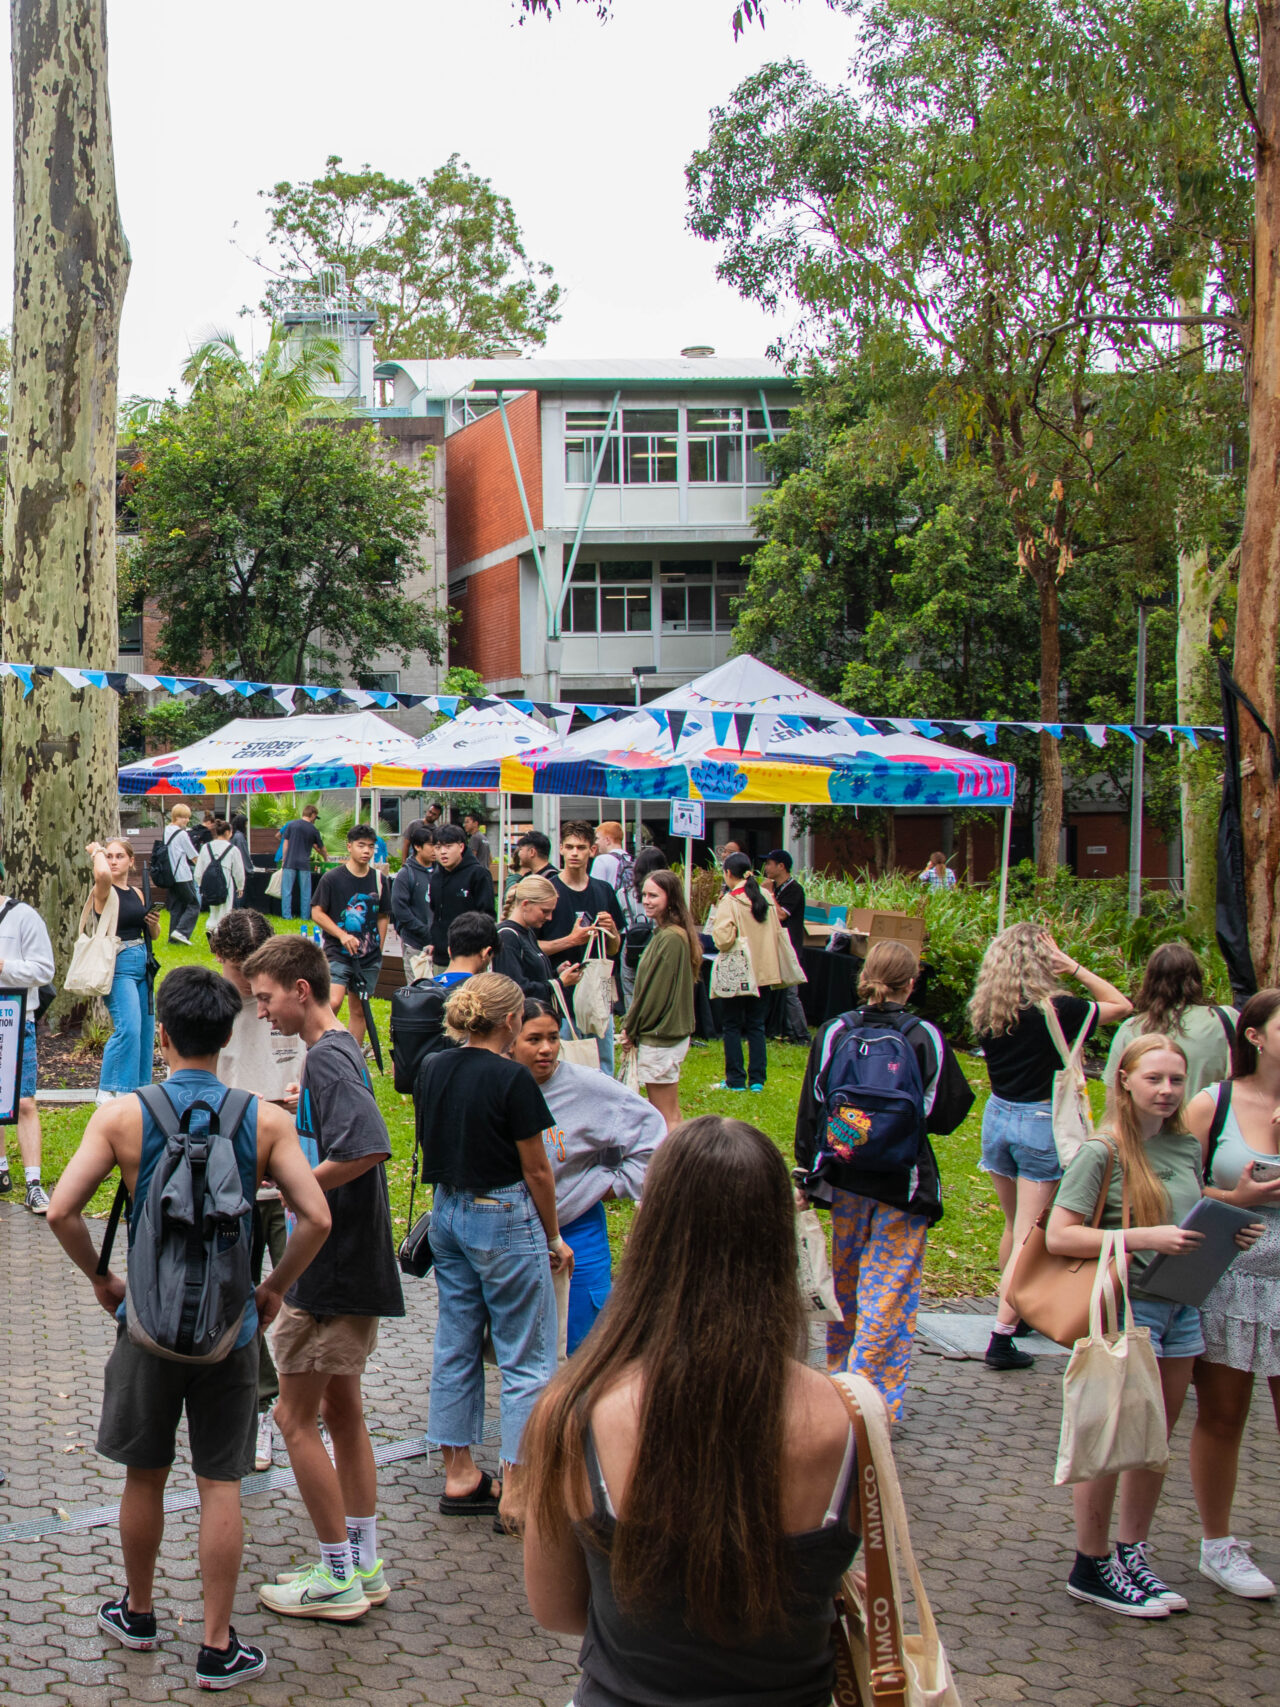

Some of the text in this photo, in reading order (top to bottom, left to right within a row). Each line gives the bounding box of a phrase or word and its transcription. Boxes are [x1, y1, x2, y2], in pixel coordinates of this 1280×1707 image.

[232, 749, 291, 758] CENTRAL
[241, 740, 306, 751] STUDENT
[4, 1008, 14, 1017] TO
[864, 1464, 883, 1549] MIMCO
[330, 1559, 346, 1581] BEST
[873, 1597, 899, 1683] MIMCO
